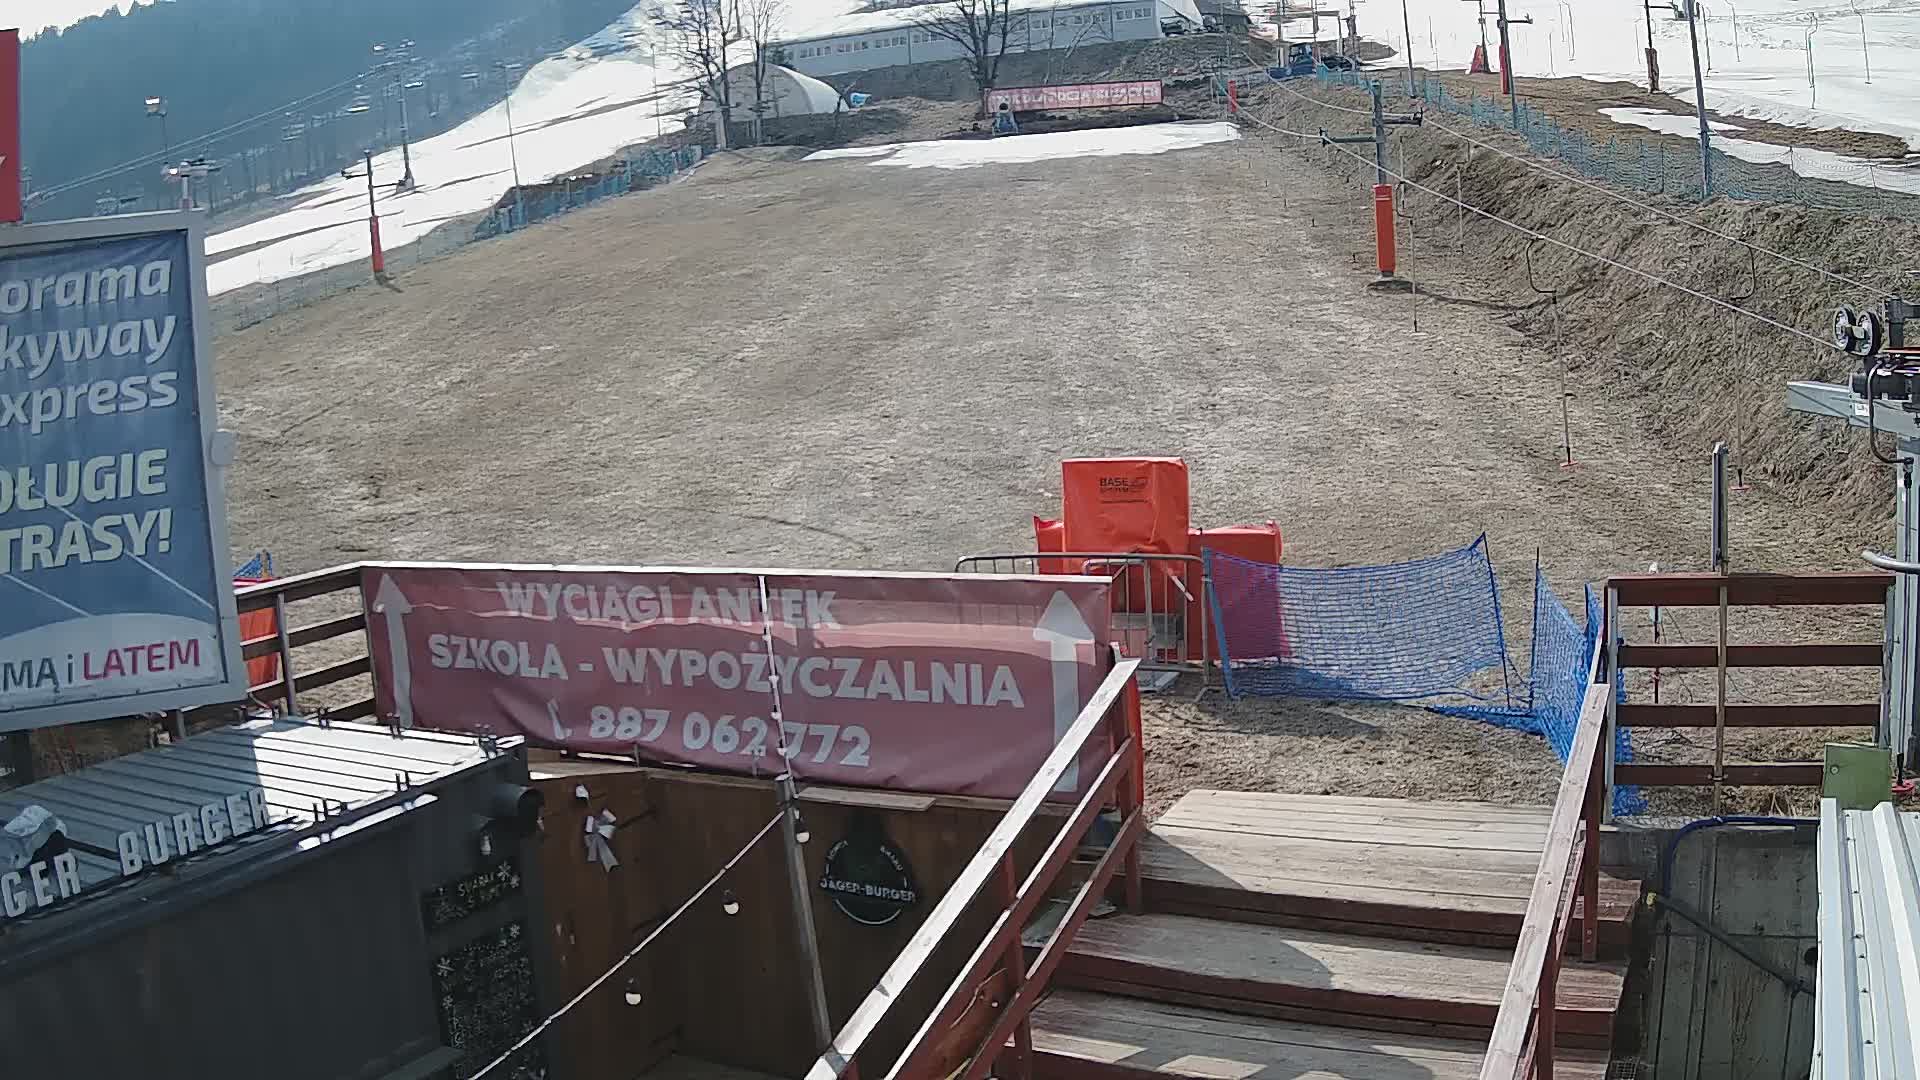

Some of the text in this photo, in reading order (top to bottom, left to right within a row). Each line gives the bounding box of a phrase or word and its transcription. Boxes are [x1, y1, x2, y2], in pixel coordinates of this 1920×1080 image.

[67, 653, 74, 685] i
[83, 638, 201, 681] LATEM
[601, 640, 1025, 708] WYPOŻYCZALNIA
[589, 705, 871, 767] 887 062 772
[117, 787, 270, 877] BURGER
